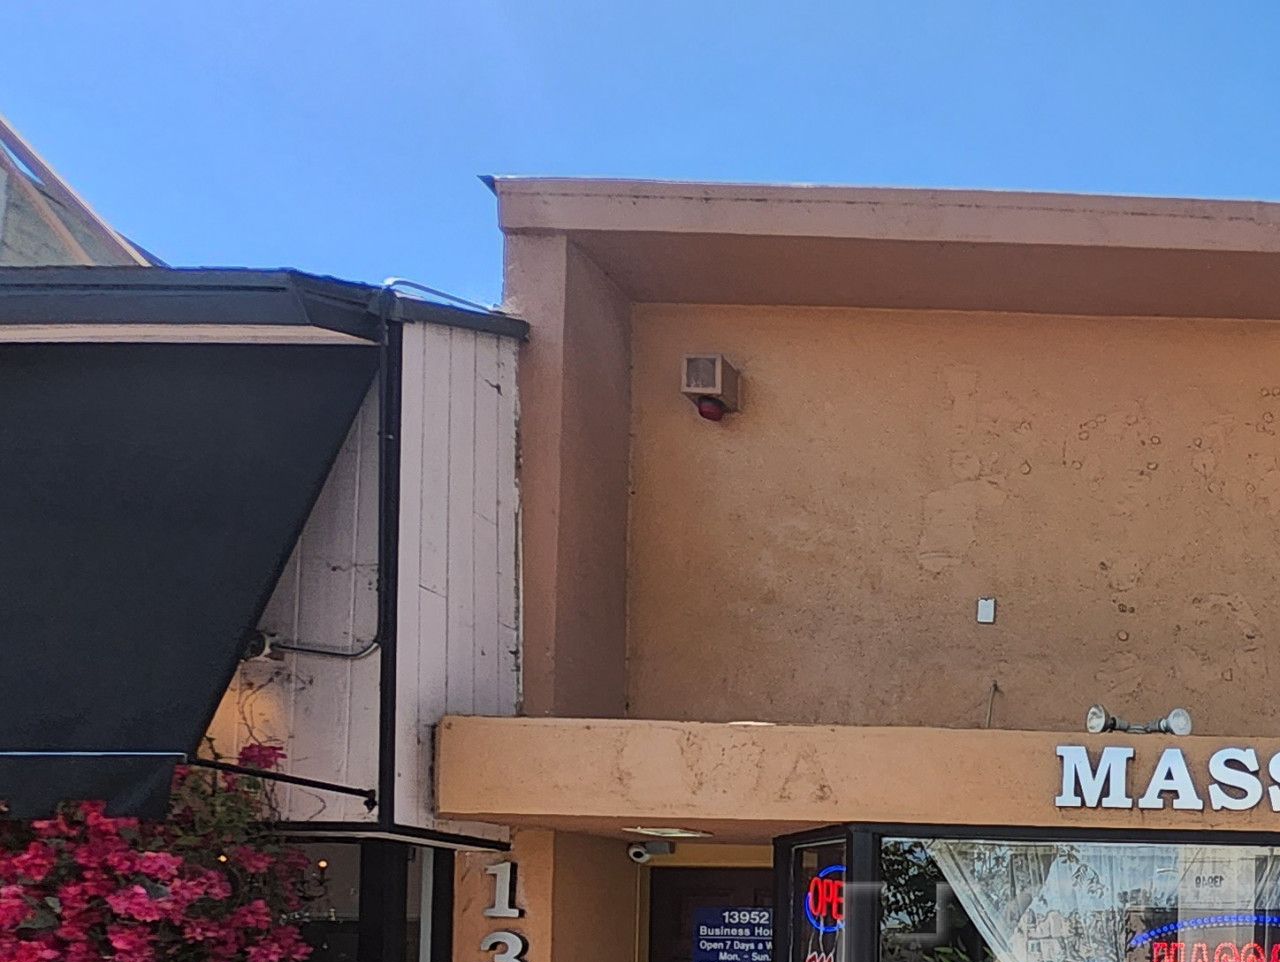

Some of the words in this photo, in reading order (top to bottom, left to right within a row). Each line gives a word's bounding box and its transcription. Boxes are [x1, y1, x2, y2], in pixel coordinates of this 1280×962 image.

[810, 877, 846, 920] OPE
[722, 911, 770, 924] 13952
[700, 925, 750, 936] Business
[699, 940, 724, 951] Open
[725, 941, 731, 950] 7
[733, 941, 755, 951] Days
[757, 942, 763, 950] a
[718, 952, 740, 961] Mon.
[751, 952, 771, 961] Sun.
